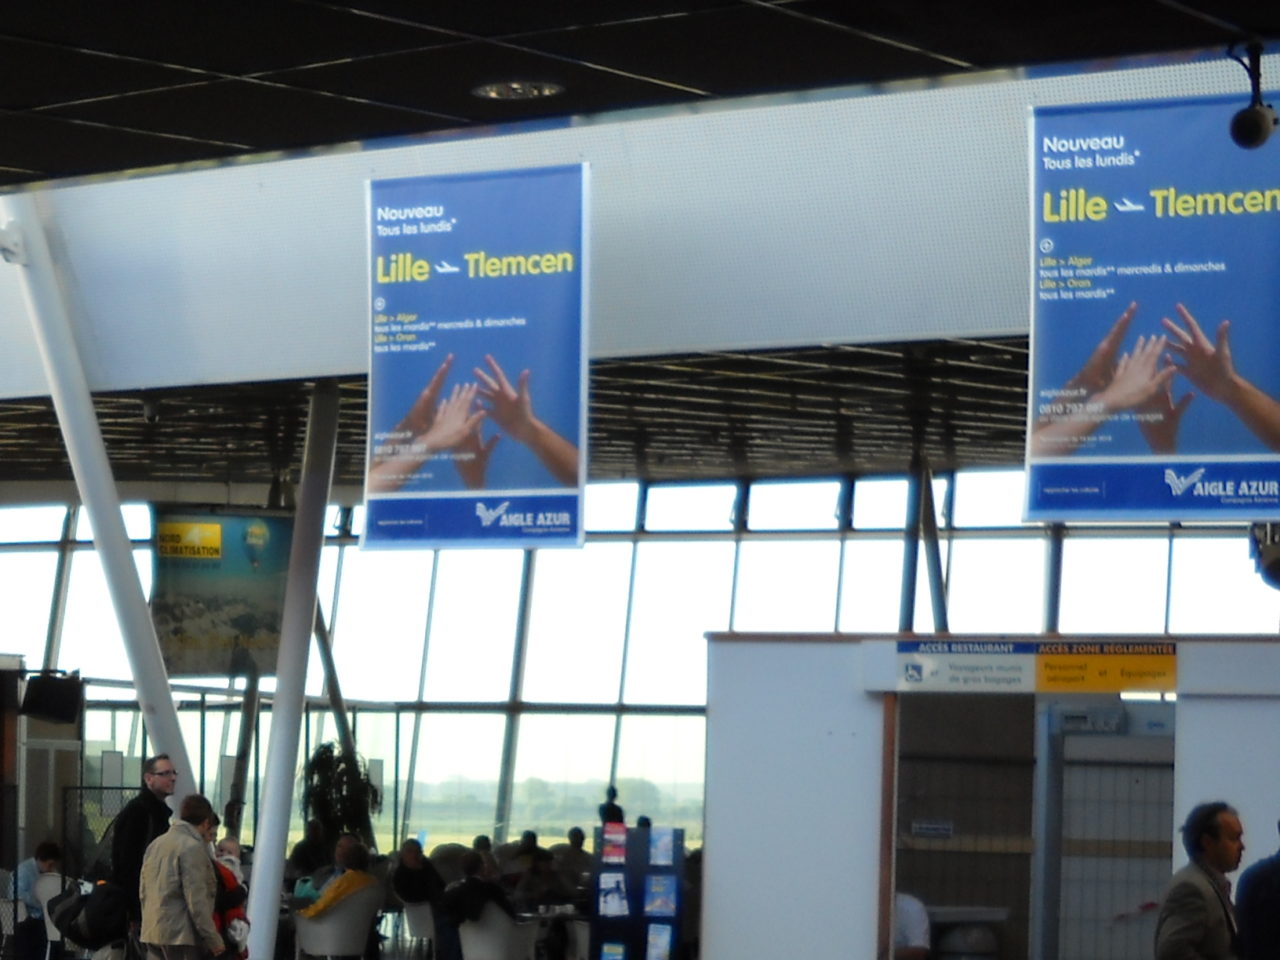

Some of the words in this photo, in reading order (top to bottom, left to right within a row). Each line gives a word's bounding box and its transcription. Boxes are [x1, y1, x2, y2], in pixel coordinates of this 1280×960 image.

[1043, 136, 1124, 153] Nouveau
[1043, 157, 1070, 169] Tous
[1075, 156, 1093, 168] les
[1043, 188, 1108, 222] Lille
[377, 206, 444, 221] Nouveau
[377, 225, 400, 236] Tous
[402, 223, 418, 235] les
[376, 253, 430, 283] Lille
[464, 251, 573, 278] Tlemcen
[1068, 256, 1093, 268] Alger
[1117, 264, 1163, 275] mercredis
[1174, 261, 1226, 273] dimanches
[1067, 278, 1092, 289] Oran
[1193, 480, 1234, 496] AIGLE
[1237, 480, 1279, 496] AZUR
[499, 513, 534, 526] AIGLE
[536, 512, 570, 526] AZUR
[951, 643, 1014, 653] RESTAURANT
[1072, 644, 1100, 654] ZONE
